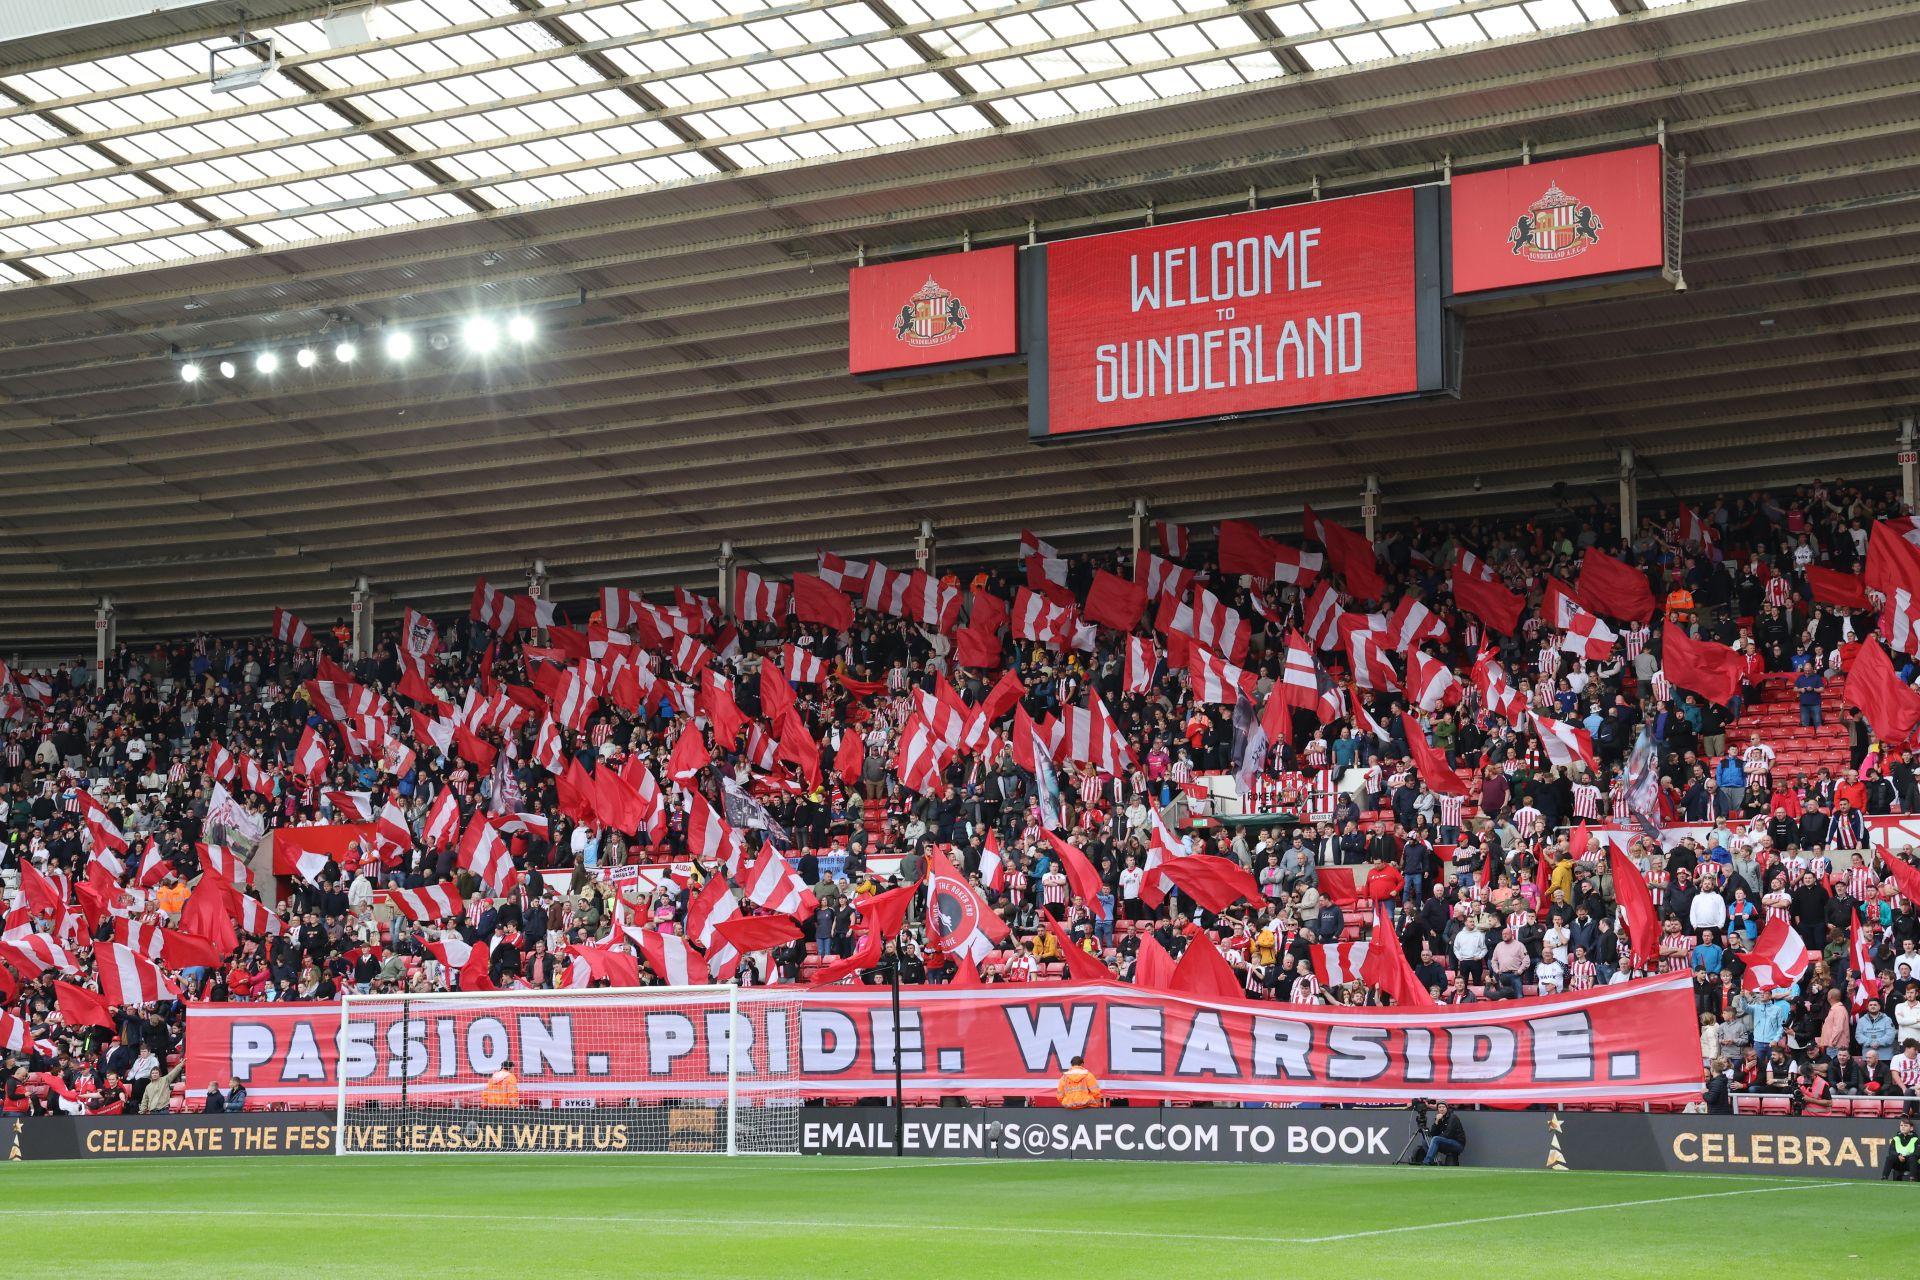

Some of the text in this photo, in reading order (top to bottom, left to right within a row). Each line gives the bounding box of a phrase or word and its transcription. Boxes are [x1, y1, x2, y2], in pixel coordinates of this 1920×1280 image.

[1131, 227, 1322, 313] WELCOME
[1216, 307, 1236, 321] TO
[1096, 311, 1362, 403] SUNDERLAND
[1247, 792, 1275, 801] ROKER
[951, 886, 969, 904] ROKER
[230, 1002, 1641, 1083] PASSION. PRIDE. WEARSIDE.
[564, 1099, 592, 1107] SYKES
[86, 1127, 223, 1152] CELEBRATE
[231, 1126, 278, 1150] THE
[513, 1124, 583, 1149] WITH
[594, 1124, 628, 1149] US
[803, 1122, 893, 1148] EMAIL
[1229, 1125, 1275, 1152] TO
[1287, 1125, 1391, 1154] BOOK
[1672, 1132, 1893, 1168] CELEBRAT
